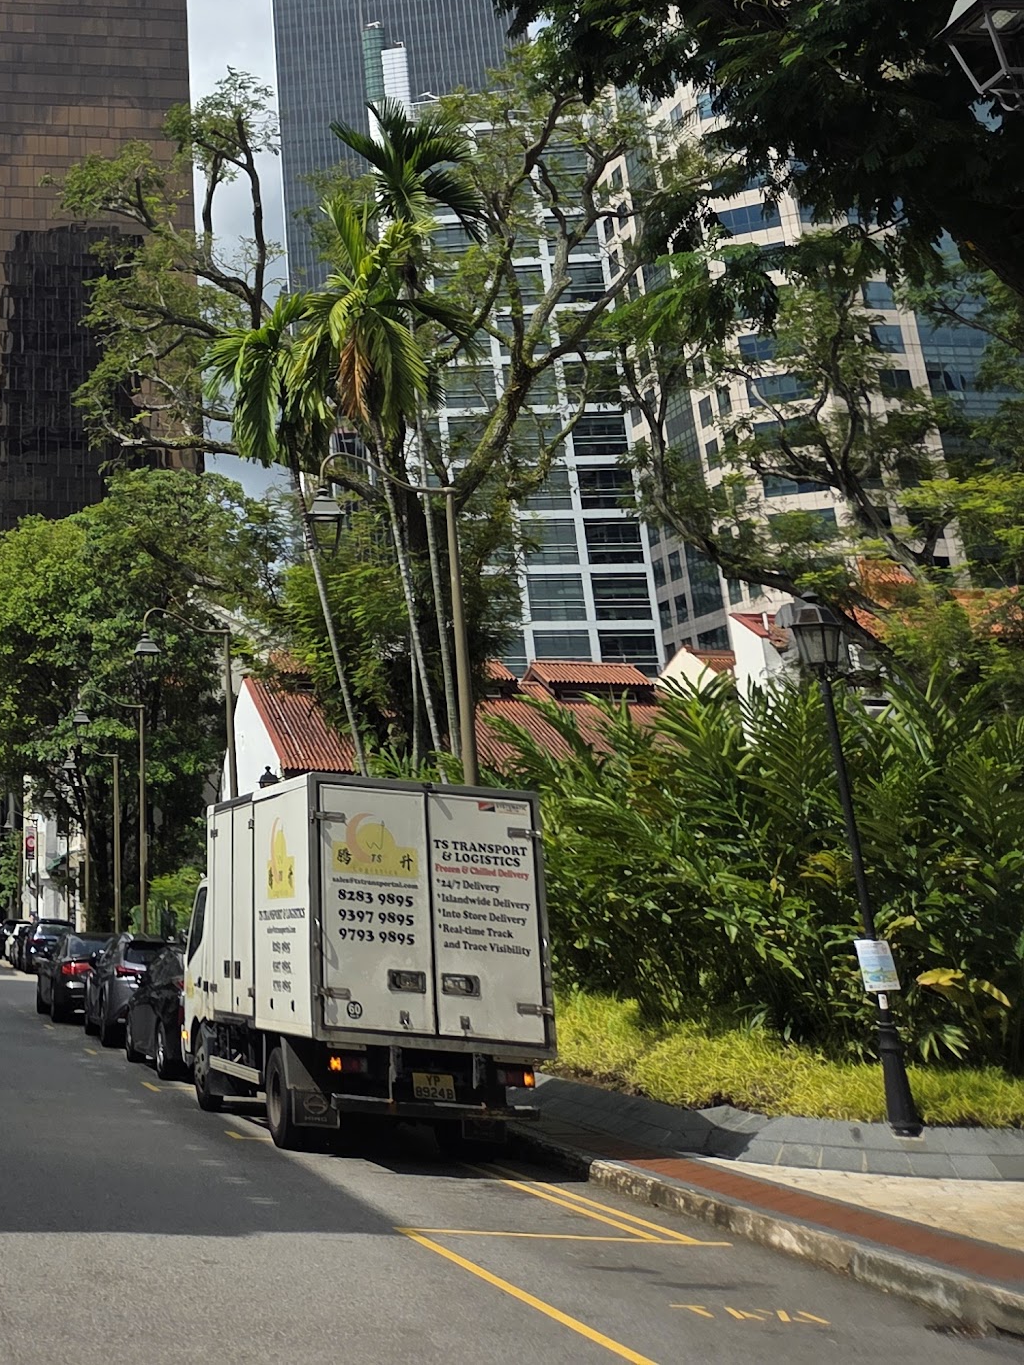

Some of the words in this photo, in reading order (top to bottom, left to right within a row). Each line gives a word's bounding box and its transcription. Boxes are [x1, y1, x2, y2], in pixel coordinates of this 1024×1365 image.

[433, 839, 449, 850] TS
[451, 840, 528, 857] TRANSPORT
[370, 853, 383, 863] TS
[399, 853, 414, 872] 升
[442, 851, 452, 862] &
[455, 852, 521, 868] LOGISTICS
[352, 865, 398, 876] Logistics
[434, 863, 460, 874] Frozen
[462, 865, 468, 874] &
[470, 866, 496, 877] Chilled
[498, 869, 530, 881] Delivery
[441, 878, 461, 890] 24/7
[463, 880, 500, 894] Delivery
[338, 888, 374, 904] 8283
[377, 892, 414, 908] 9895
[441, 893, 491, 907] Islandwide
[493, 898, 531, 912] Delivery
[338, 908, 374, 924] 9397
[378, 911, 415, 927] 9895
[442, 908, 461, 919] Into
[463, 910, 487, 922] Store
[489, 913, 527, 927] Delivery
[338, 927, 375, 942] 9793
[378, 930, 415, 946] 9895
[442, 924, 485, 936] Real-time
[486, 928, 514, 939] Track
[444, 940, 461, 950] and
[462, 941, 488, 952] Trace
[489, 943, 532, 958] Visibility
[348, 1003, 362, 1015] 60
[426, 1074, 441, 1085] YP
[415, 1086, 454, 1100] 8924B
[304, 1115, 328, 1123] HINO
